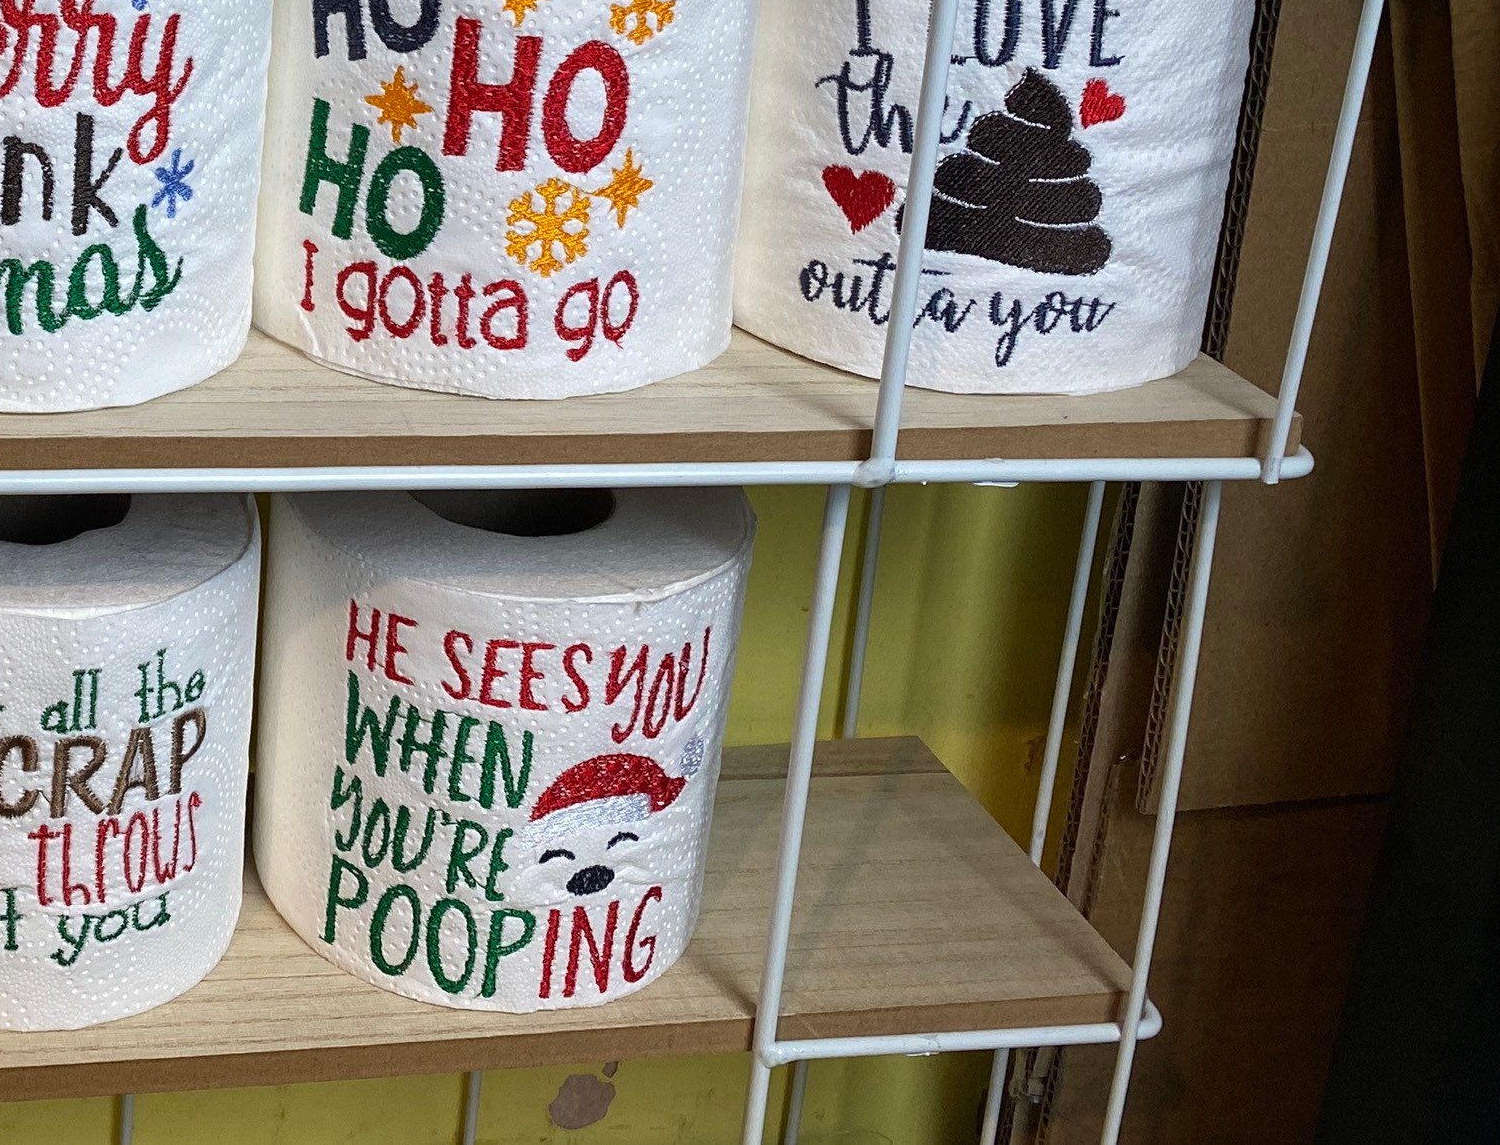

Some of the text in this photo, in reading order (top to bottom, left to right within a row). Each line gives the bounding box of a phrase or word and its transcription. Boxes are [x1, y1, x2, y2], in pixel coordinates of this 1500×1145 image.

[441, 15, 631, 175] HO
[299, 96, 447, 261] HO
[300, 238, 641, 362] I gotta go
[799, 251, 1118, 368] outa you
[40, 667, 102, 735] all
[134, 647, 206, 725] the
[345, 598, 419, 686] HE
[441, 629, 593, 714] SEES
[345, 669, 535, 810] WHEN
[28, 791, 203, 908] throws
[50, 891, 171, 967] you
[318, 853, 663, 1001] POOPING
